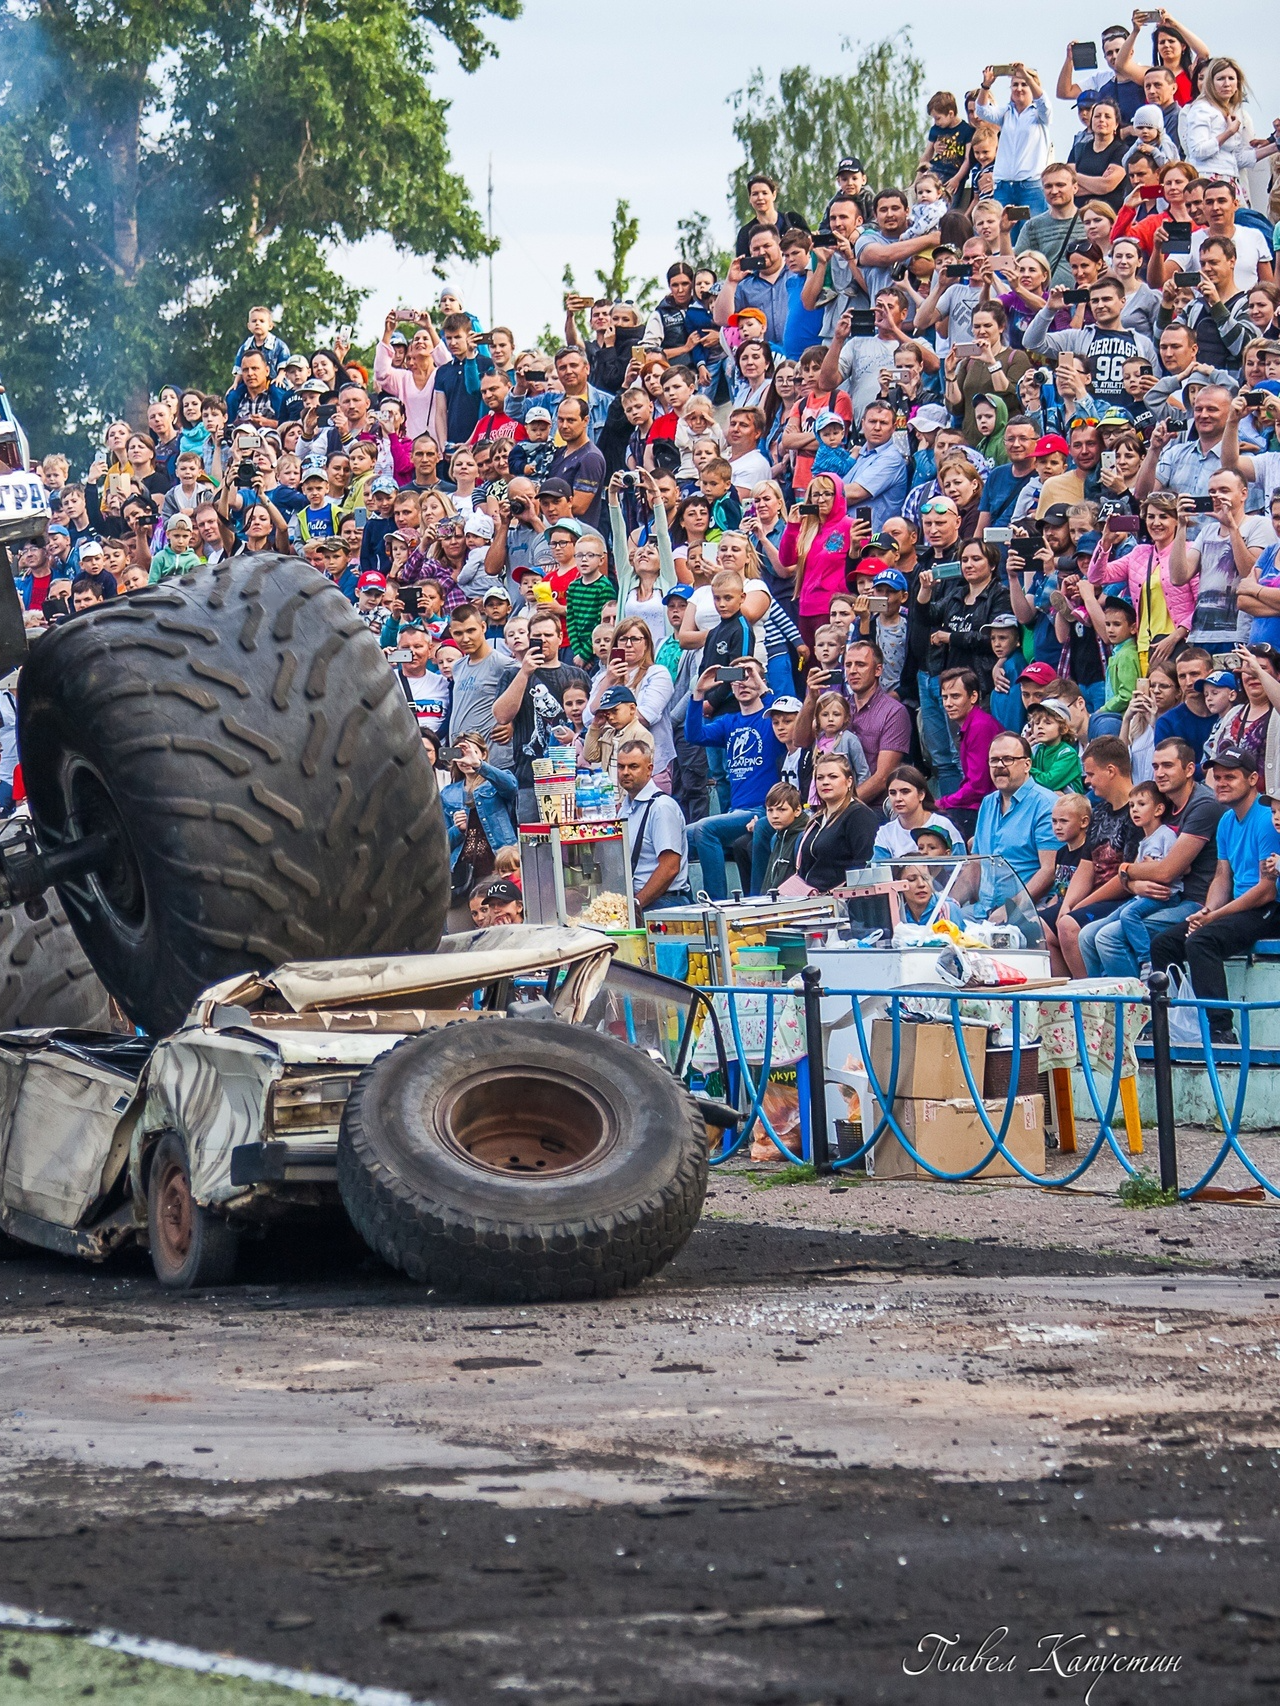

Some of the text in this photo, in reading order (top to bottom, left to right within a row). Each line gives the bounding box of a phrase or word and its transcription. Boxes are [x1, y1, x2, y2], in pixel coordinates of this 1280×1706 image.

[1088, 337, 1138, 357] HERITAGE
[1096, 356, 1126, 382] 96
[487, 884, 508, 896] NYC
